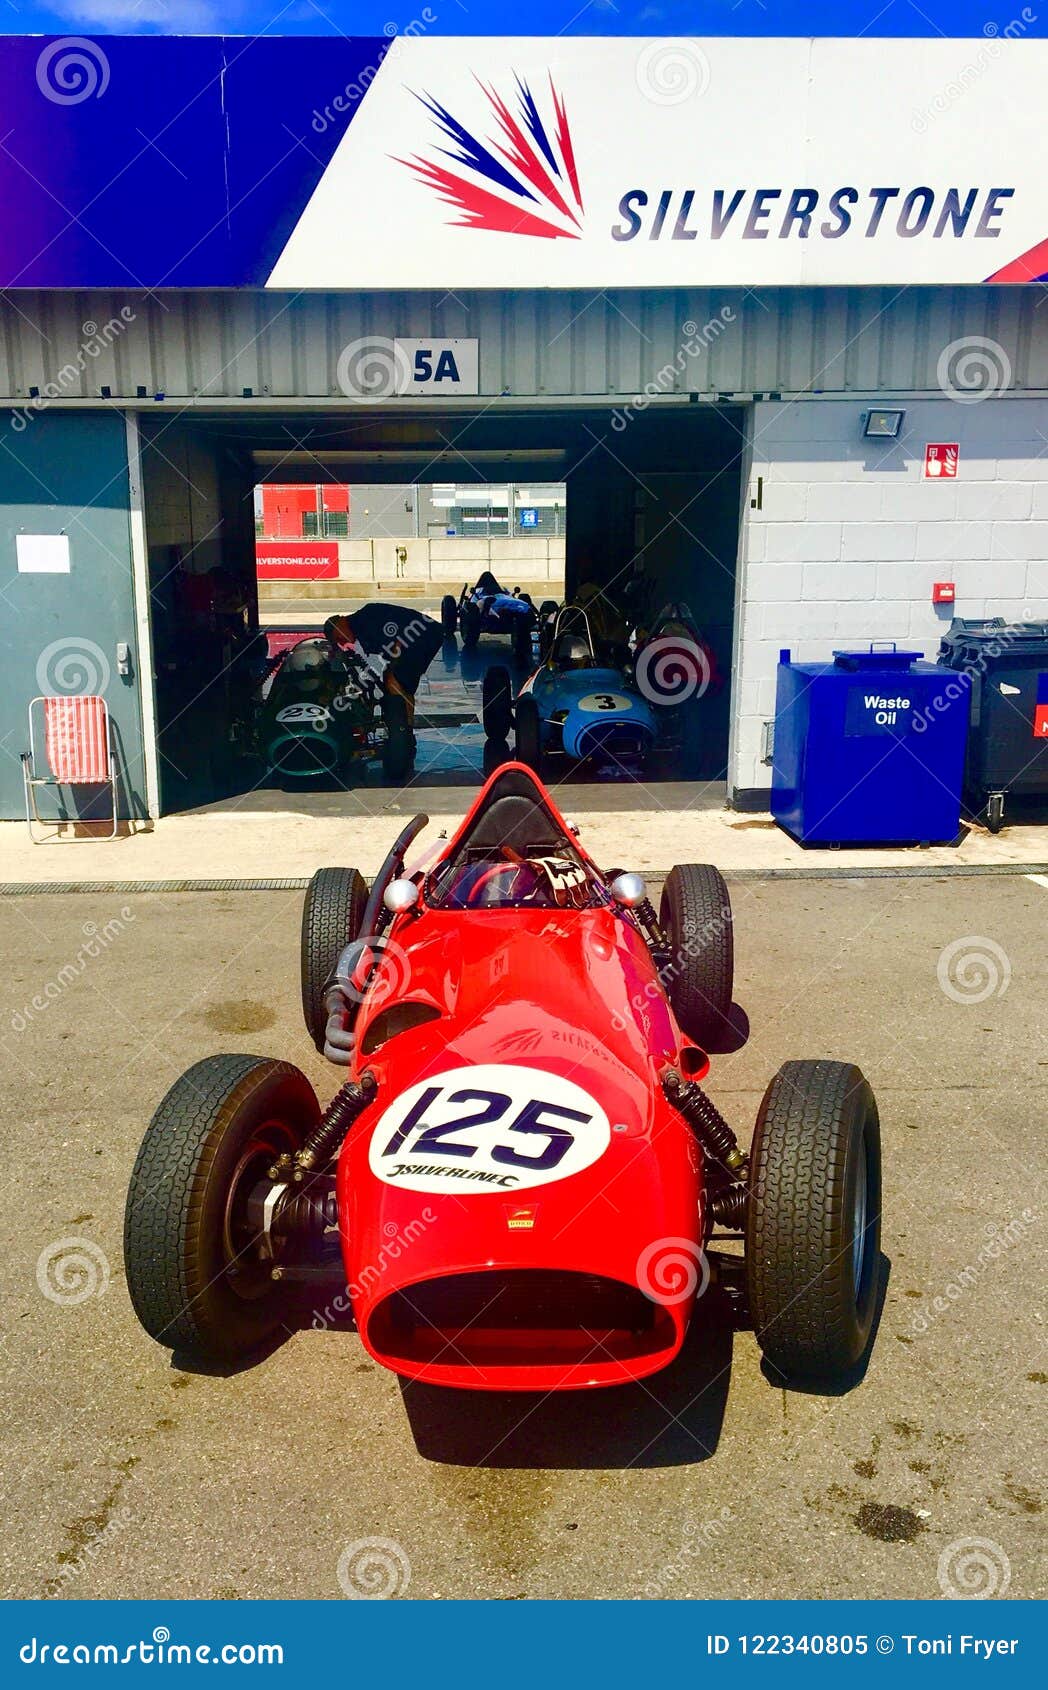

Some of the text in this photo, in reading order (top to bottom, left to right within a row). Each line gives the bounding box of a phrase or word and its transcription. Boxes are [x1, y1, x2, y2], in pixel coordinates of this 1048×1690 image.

[611, 187, 1015, 242] SILVERSTONE
[413, 350, 461, 382] 5A
[594, 695, 617, 709] 3
[864, 695, 911, 709] Waste
[282, 707, 325, 720] 29
[875, 711, 897, 725] Oil
[381, 1087, 593, 1170] 125
